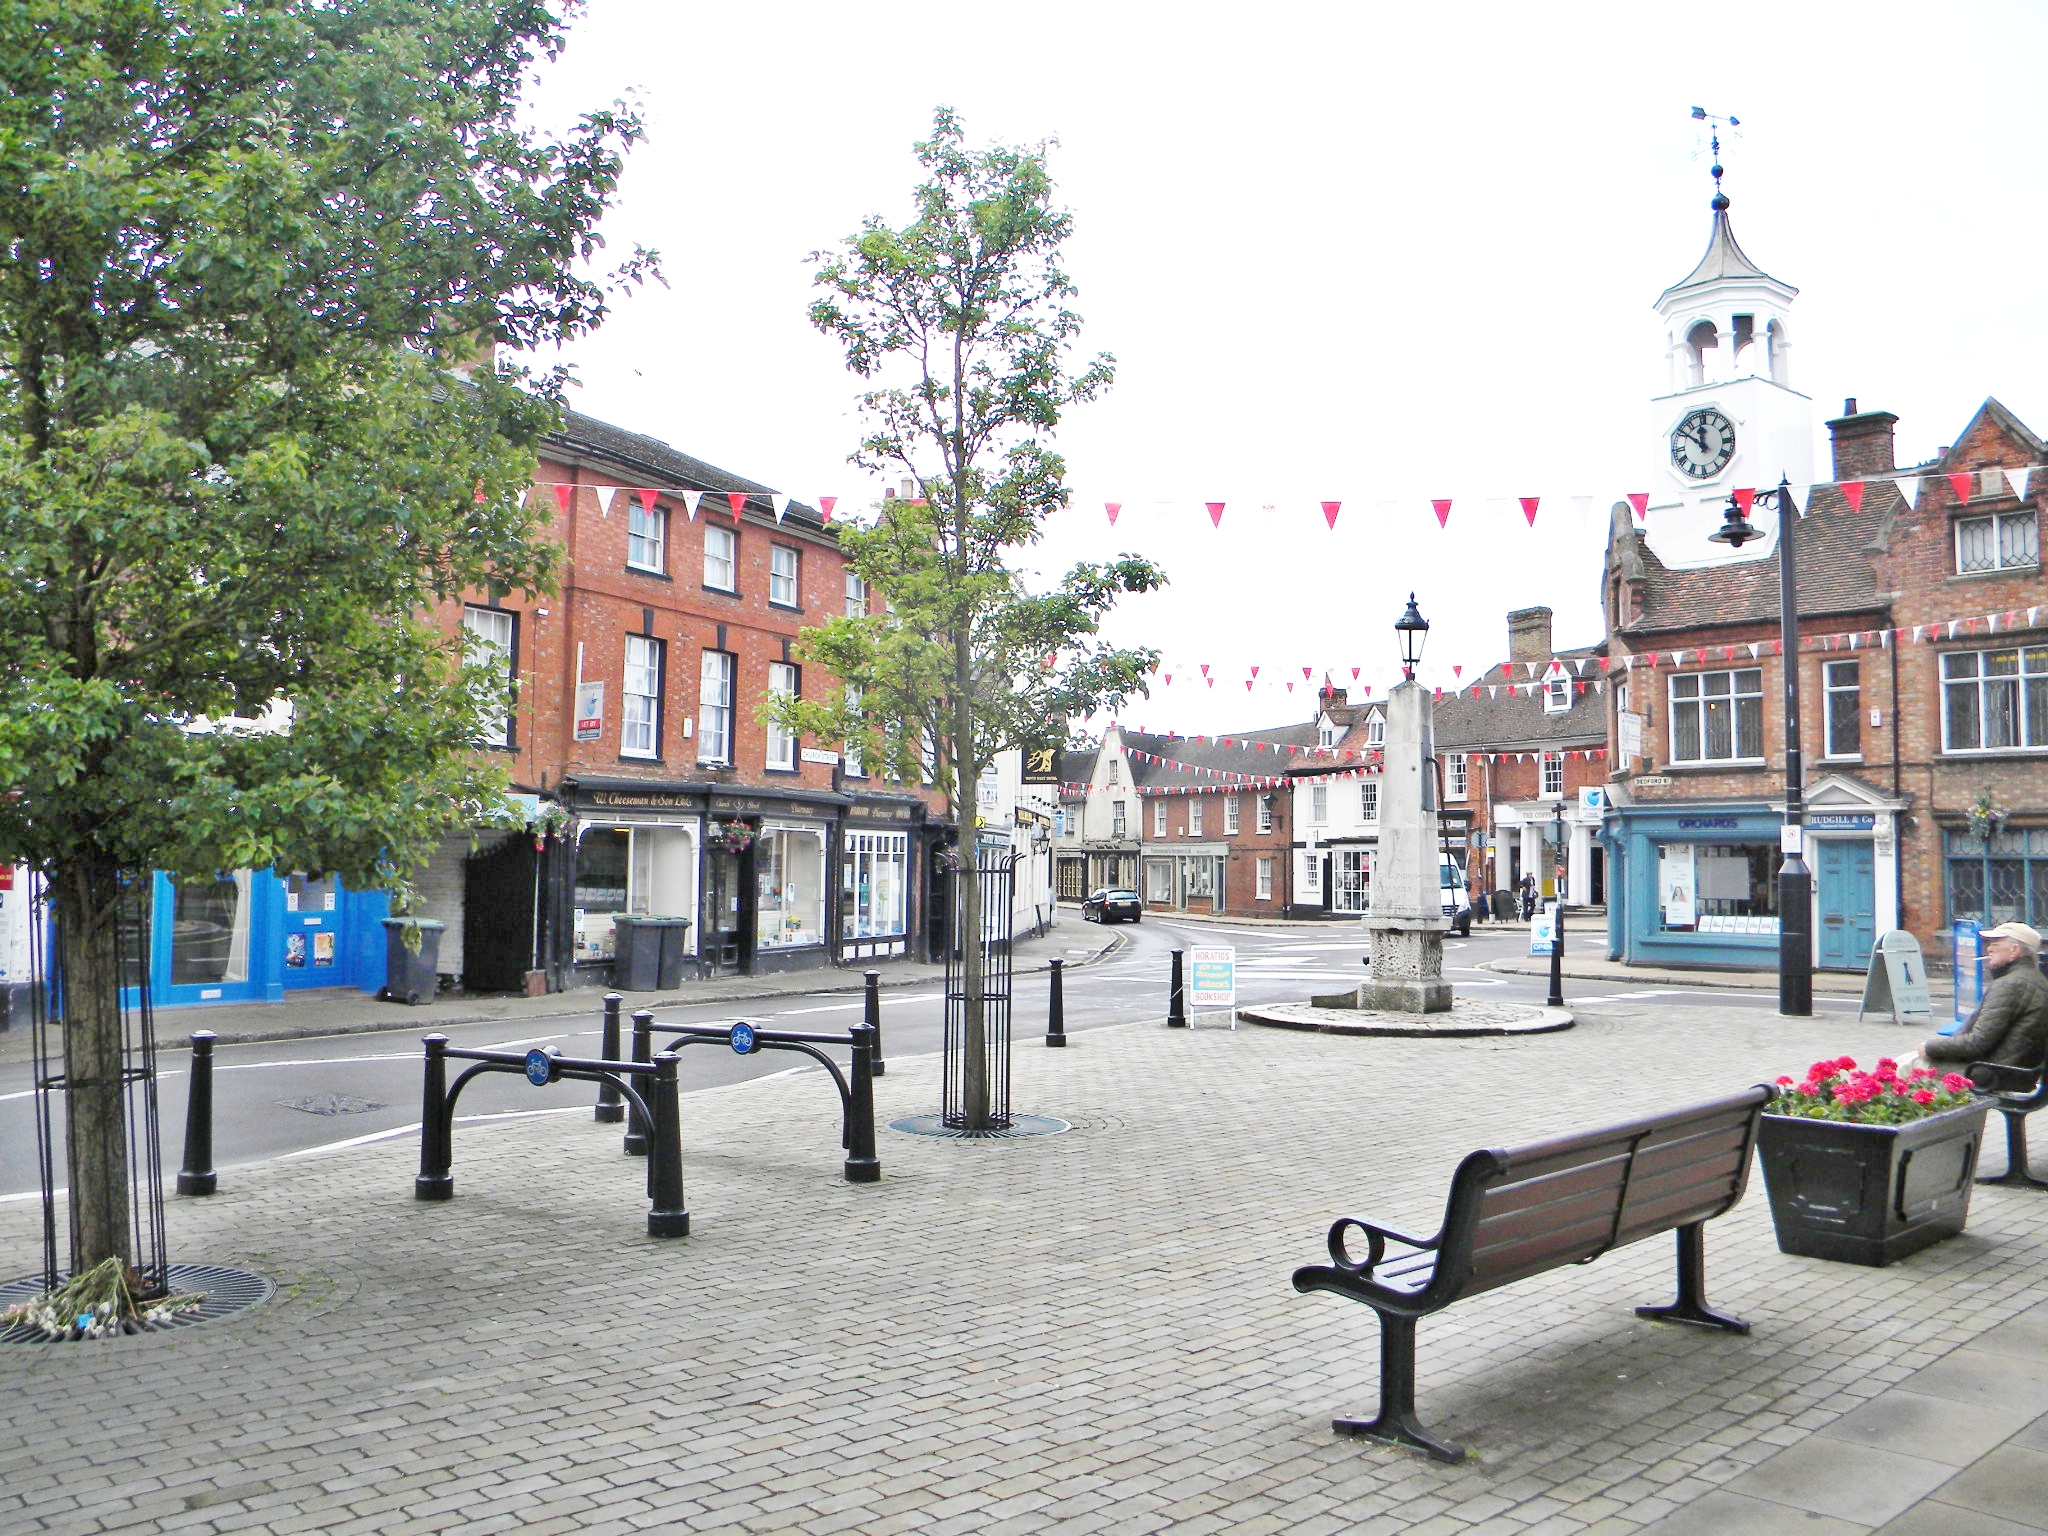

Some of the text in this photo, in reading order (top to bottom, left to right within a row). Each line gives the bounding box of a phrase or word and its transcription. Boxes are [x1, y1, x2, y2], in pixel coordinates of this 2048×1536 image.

[802, 752, 837, 761] CHURCH STREET
[608, 792, 649, 805] Cheeseman
[658, 794, 673, 806] Son
[1677, 817, 1738, 830] ORCHARDS
[1811, 815, 1873, 824] RUDGILL & Co
[1195, 992, 1231, 1001] BOOKSHOP
